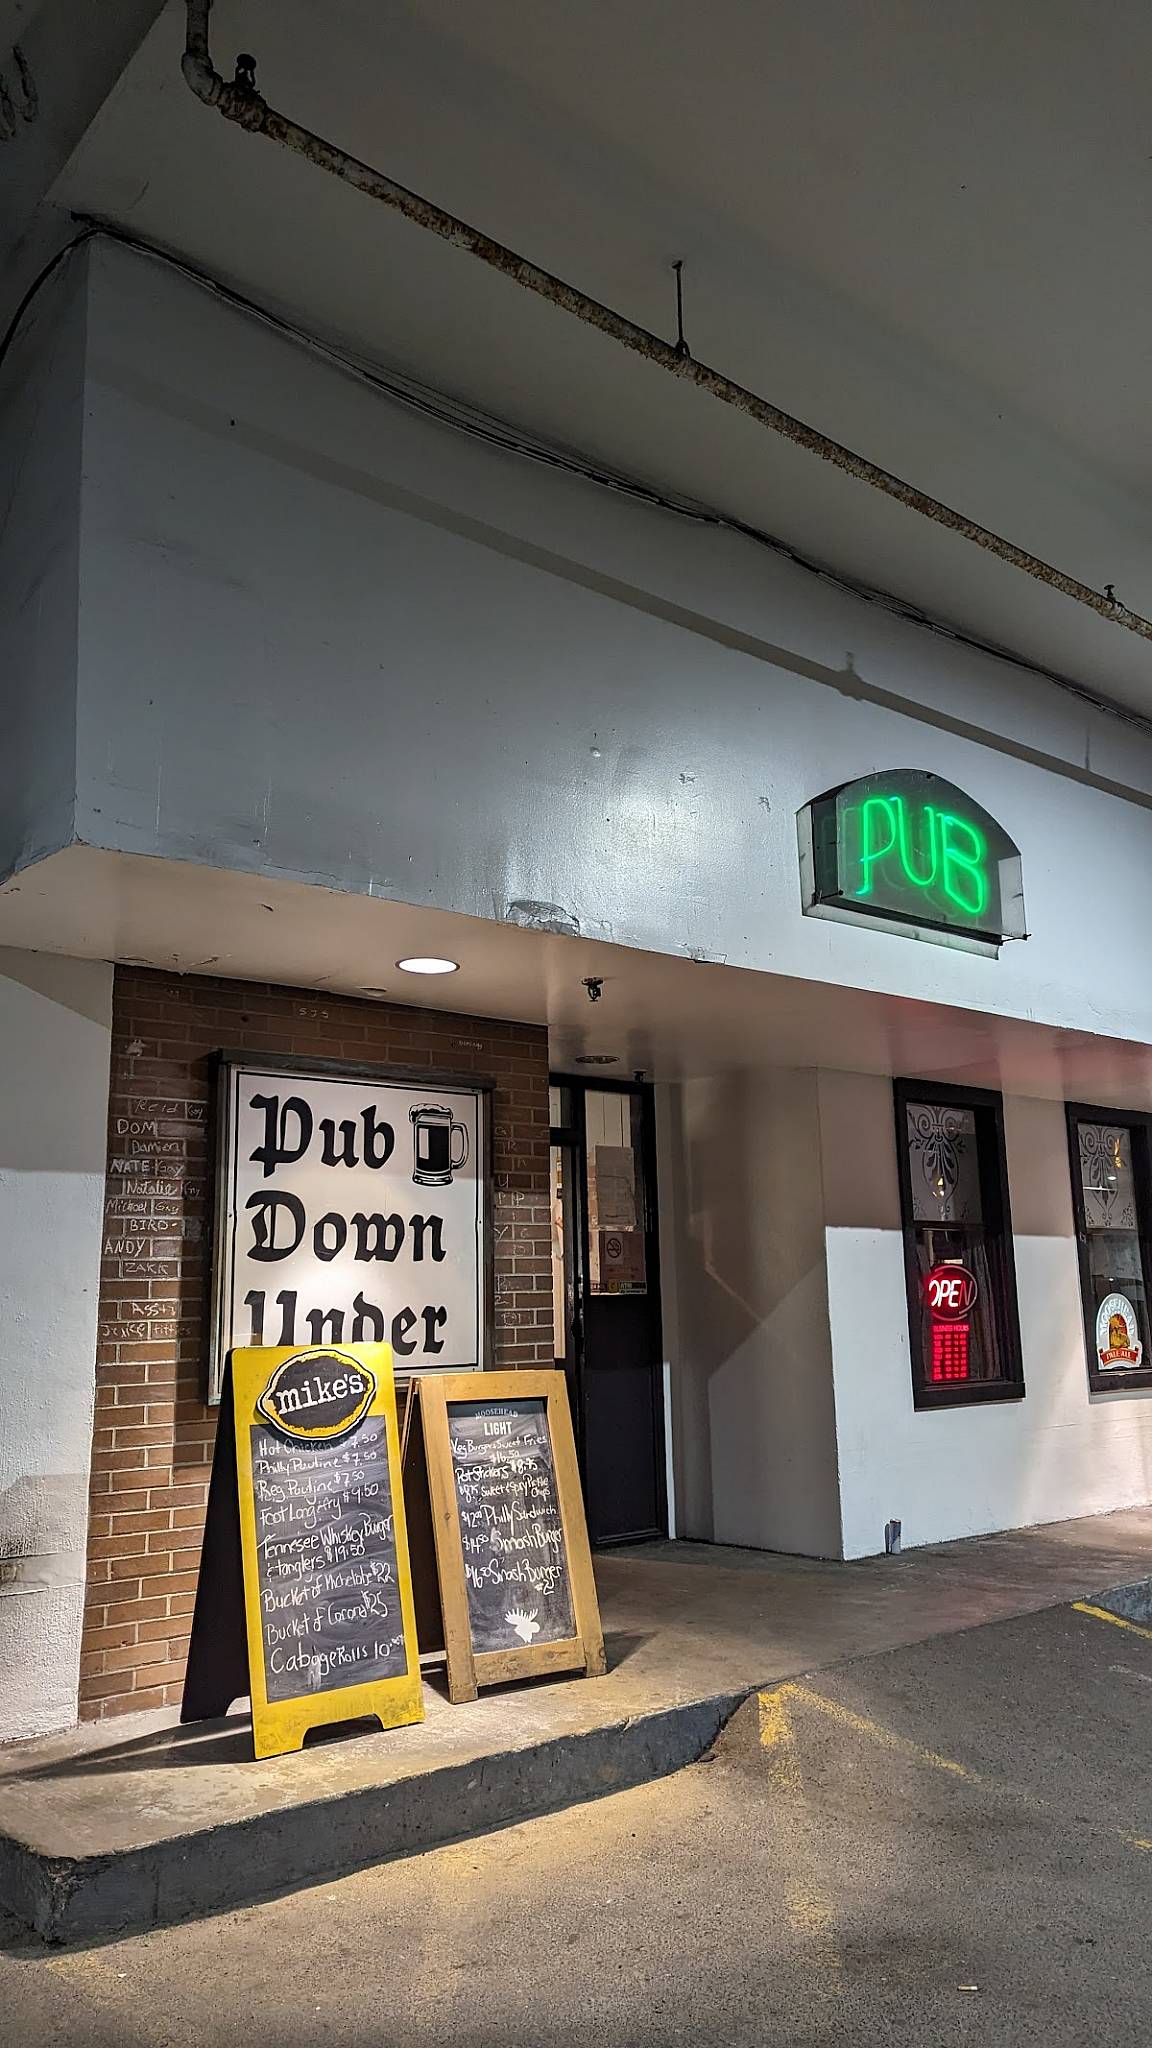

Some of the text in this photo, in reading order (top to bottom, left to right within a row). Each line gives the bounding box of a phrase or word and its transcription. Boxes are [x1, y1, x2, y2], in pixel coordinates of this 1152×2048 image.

[856, 796, 984, 914] PUB
[117, 1119, 157, 1135] DOM
[249, 1093, 395, 1178] Pub
[245, 1190, 447, 1262] Down
[104, 1239, 146, 1258] ANDY
[928, 1280, 973, 1307] OPEN
[244, 1289, 447, 1355] Under
[275, 1374, 364, 1414] mike's
[484, 1421, 512, 1436] LIGHT
[523, 1434, 547, 1446] Fries
[259, 1438, 281, 1456] Hot
[257, 1480, 285, 1502] Reg
[259, 1506, 289, 1526] Foot
[289, 1503, 318, 1529] Long
[266, 1612, 311, 1646] Bucket
